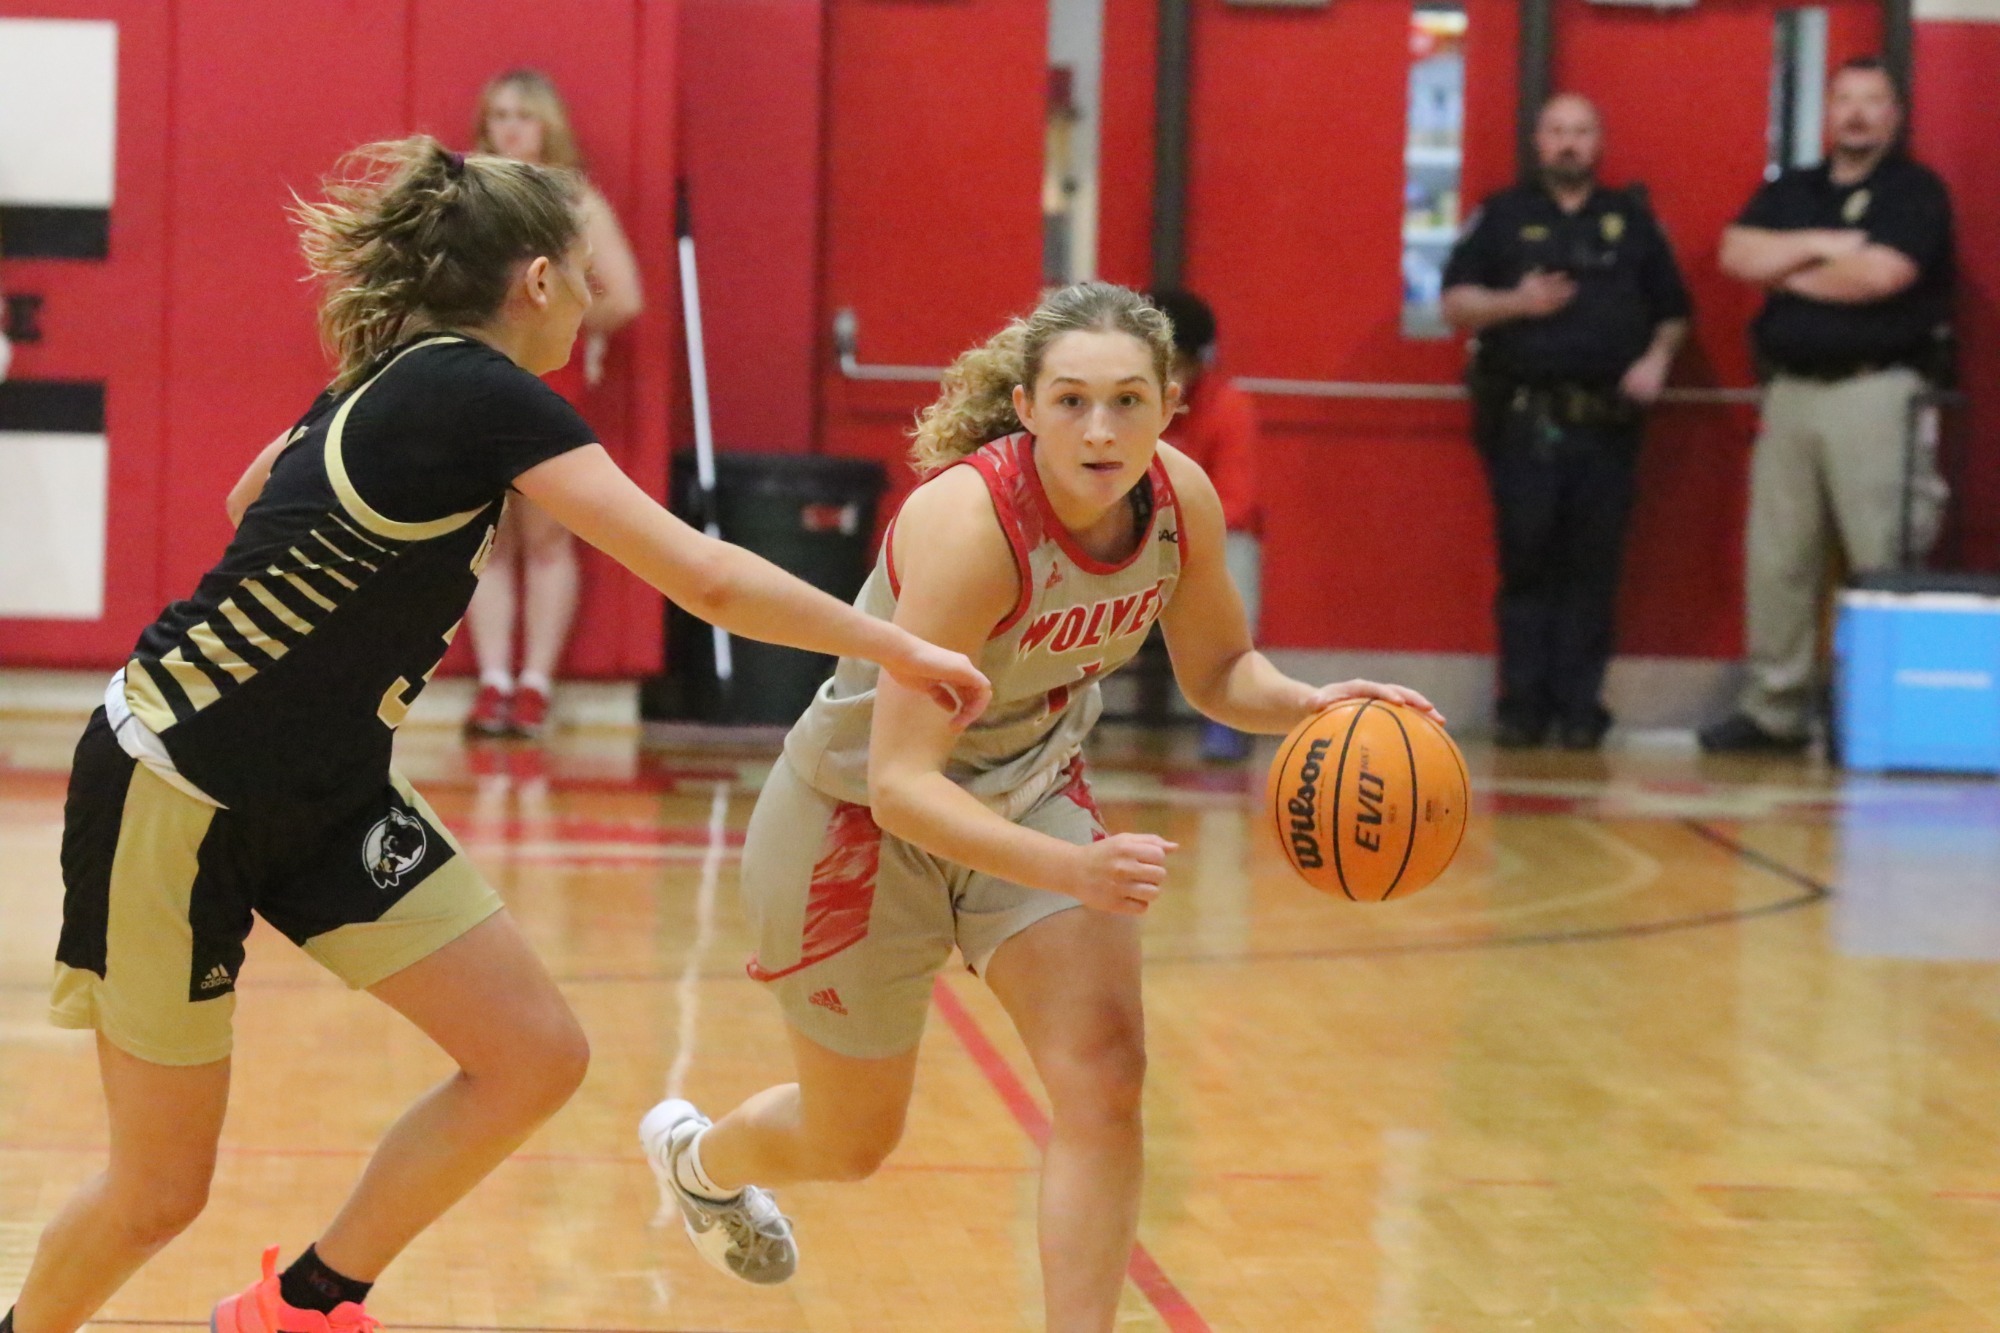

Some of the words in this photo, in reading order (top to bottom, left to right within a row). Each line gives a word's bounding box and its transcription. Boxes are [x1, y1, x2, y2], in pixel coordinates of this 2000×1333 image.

[1159, 529, 1178, 543] AC
[1288, 735, 1333, 869] Wilson
[200, 977, 232, 989] adidas
[808, 995, 848, 1016] adidas
